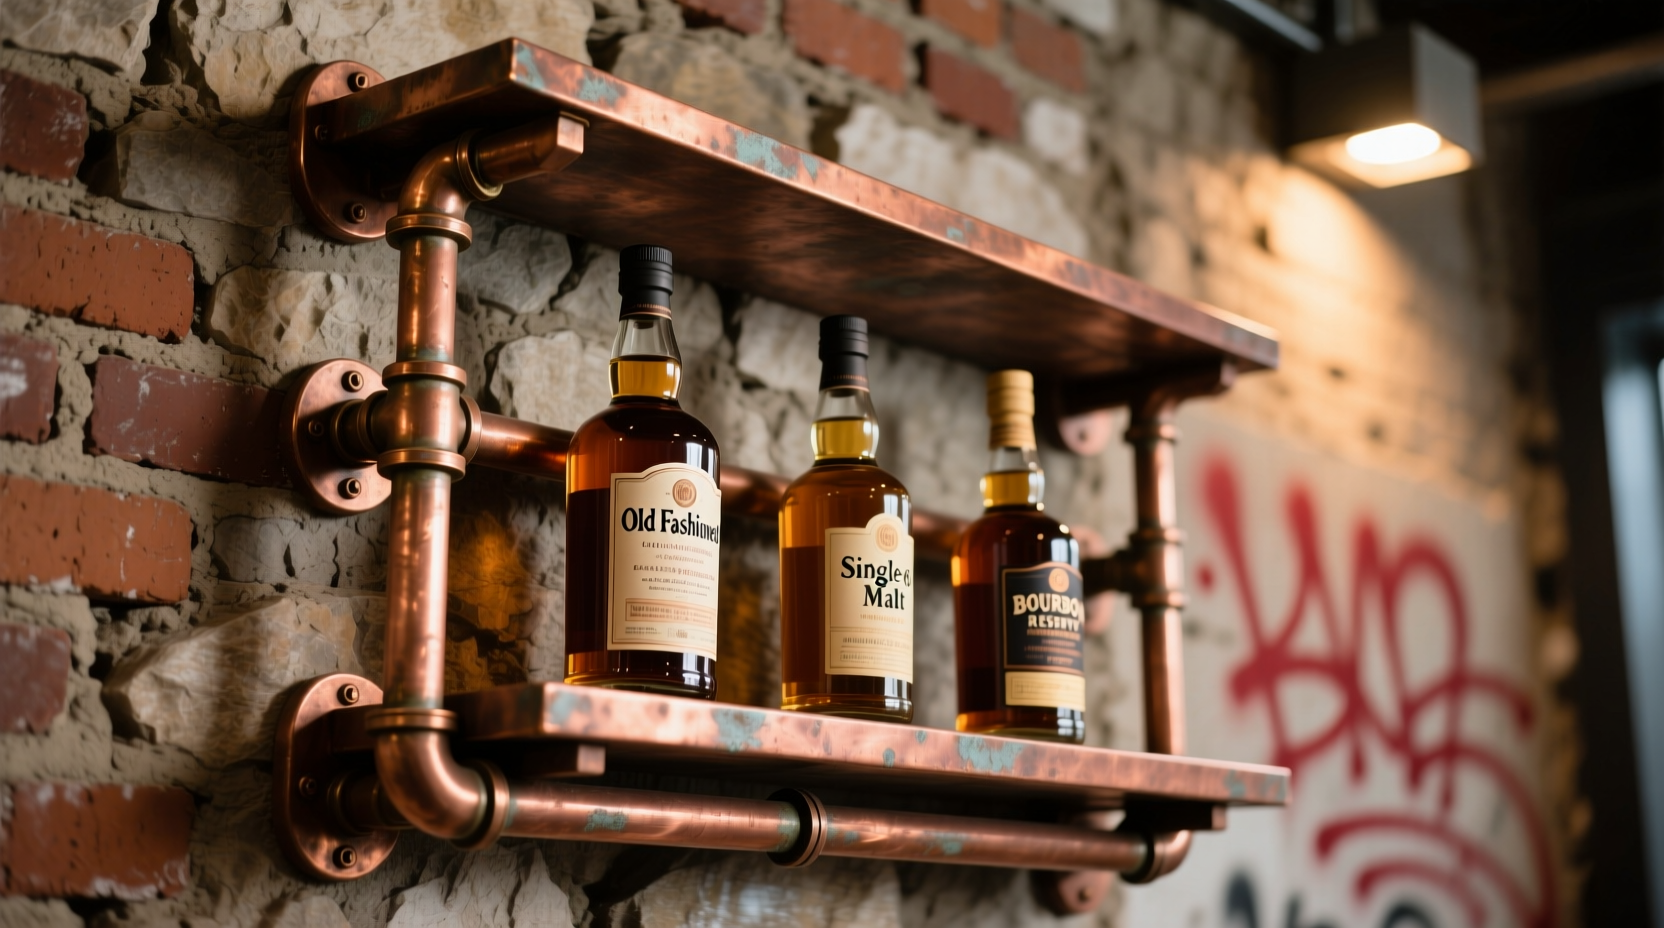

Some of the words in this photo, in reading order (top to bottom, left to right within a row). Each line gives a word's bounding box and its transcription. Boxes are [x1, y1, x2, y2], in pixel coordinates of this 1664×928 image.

[621, 507, 656, 532] Old
[841, 556, 902, 588] Single
[863, 584, 905, 611] Malt
